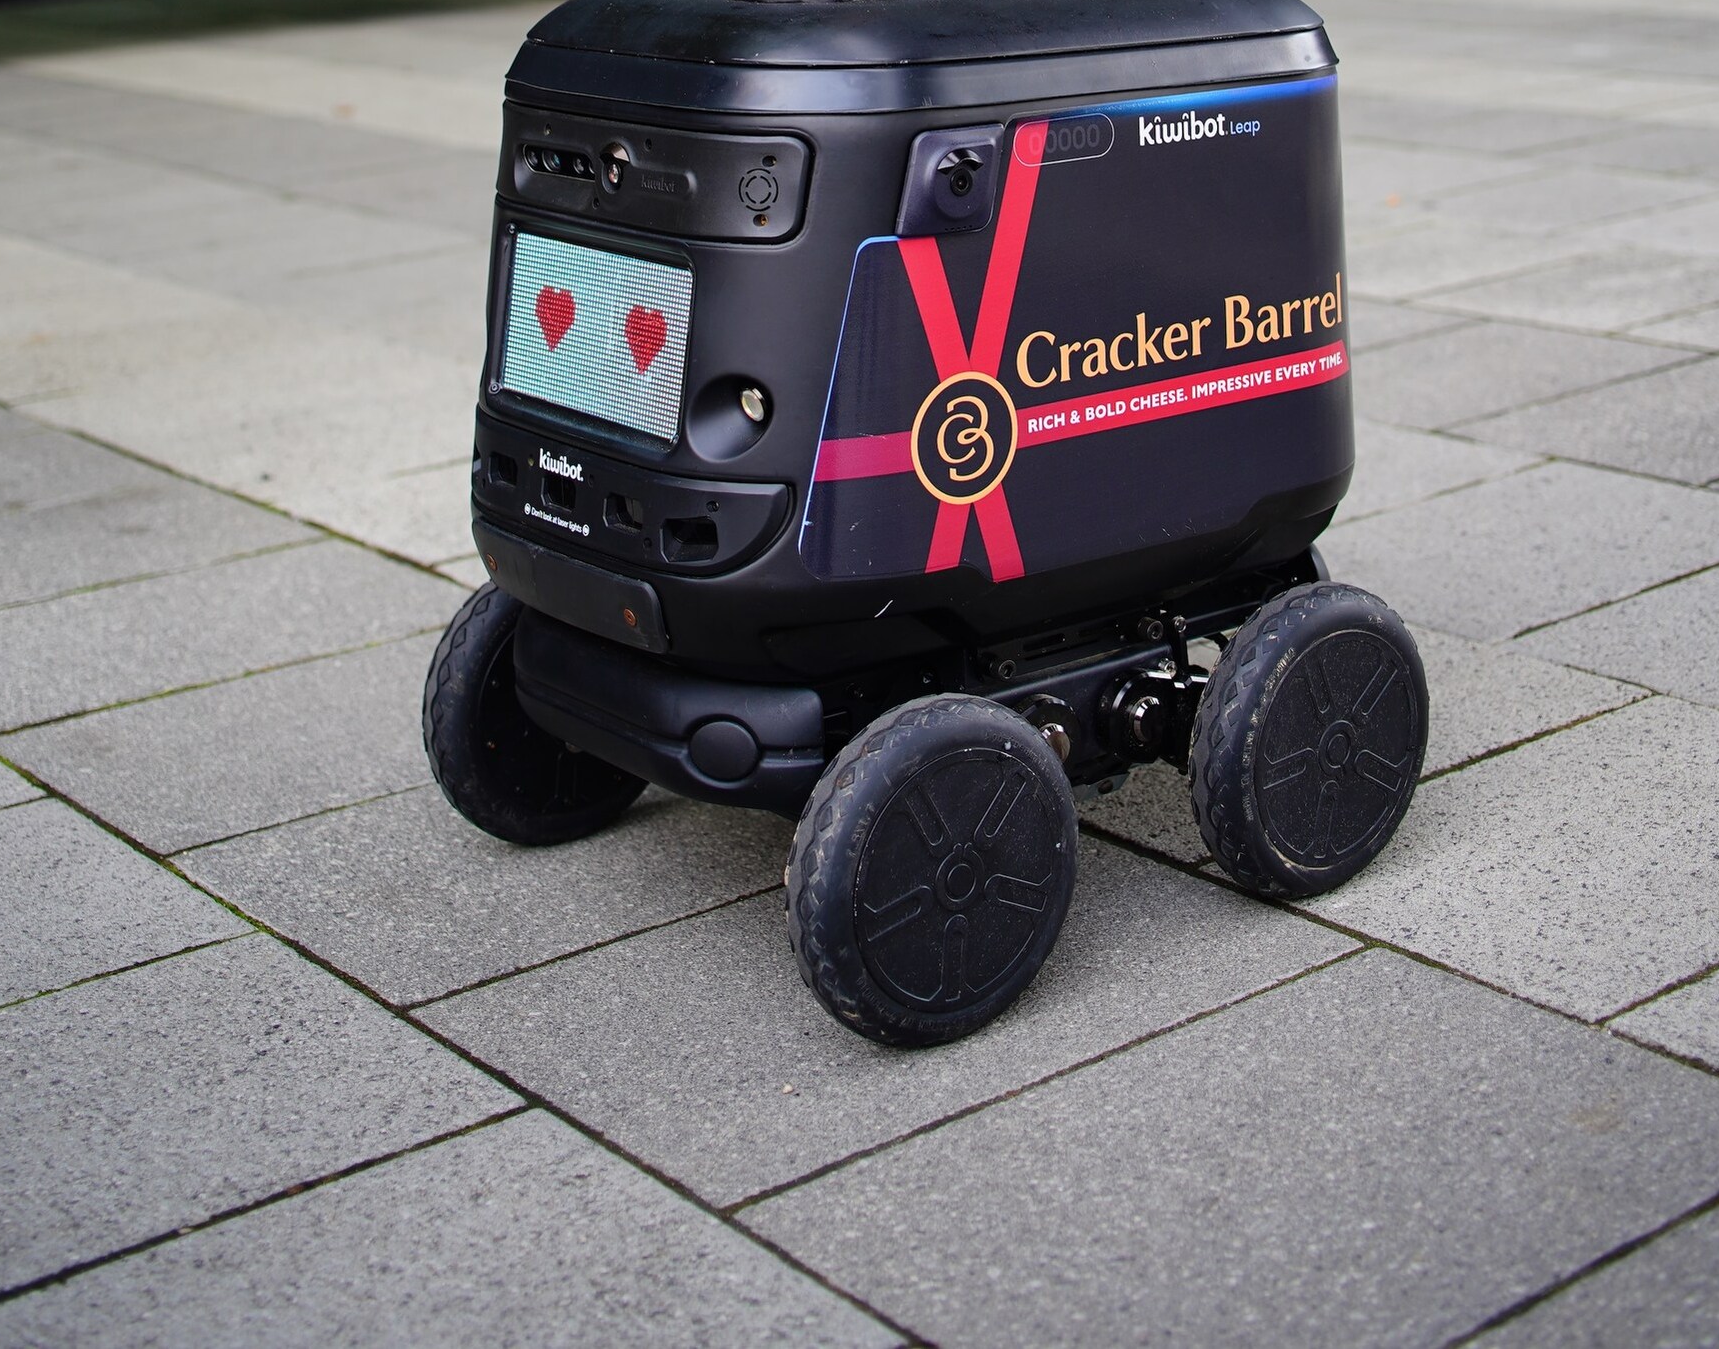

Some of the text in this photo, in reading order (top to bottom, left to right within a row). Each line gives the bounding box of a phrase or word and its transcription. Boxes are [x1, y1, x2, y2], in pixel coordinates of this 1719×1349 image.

[1230, 120, 1260, 136] Leap
[1016, 271, 1343, 388] Cracker Barrel
[1028, 352, 1343, 433] RICH & BOLD CHEESE. IMPRESSIVE EVERY TIME.
[542, 511, 552, 522] look
[568, 521, 582, 533] lights
